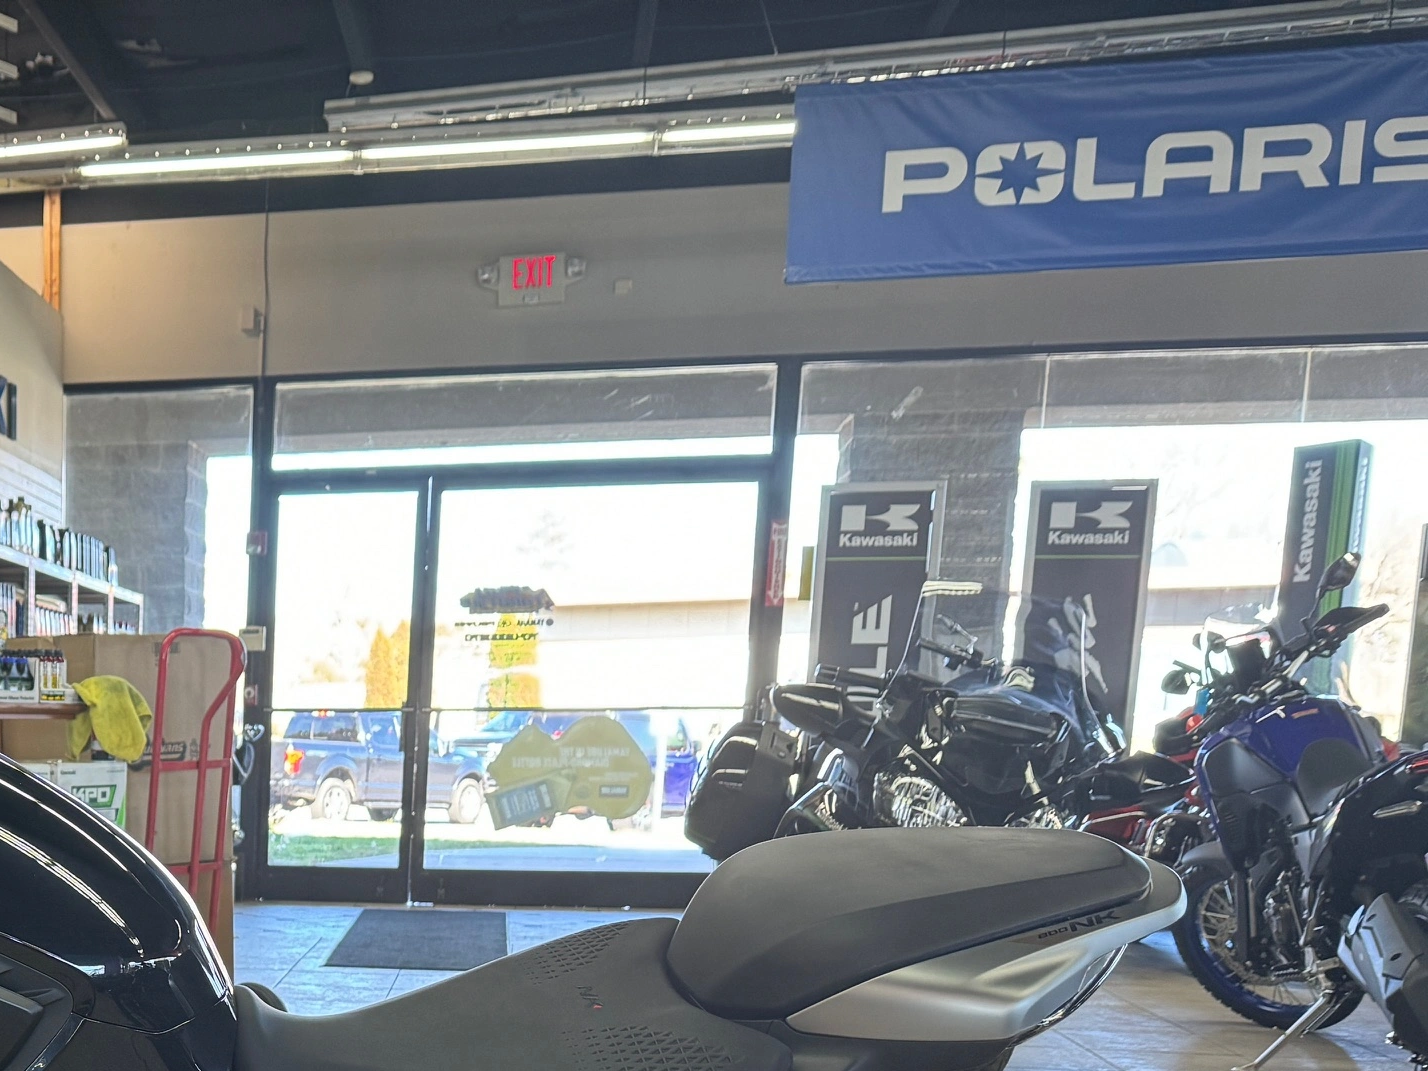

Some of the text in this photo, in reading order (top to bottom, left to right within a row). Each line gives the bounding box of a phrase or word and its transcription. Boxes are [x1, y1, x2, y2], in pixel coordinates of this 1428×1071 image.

[881, 115, 1428, 213] POLARIS
[512, 255, 557, 290] EXIT
[1293, 458, 1324, 583] Kawasaki
[838, 532, 918, 547] Kawasaki
[1047, 530, 1131, 546] Kawasaki
[1069, 910, 1121, 932] NK
